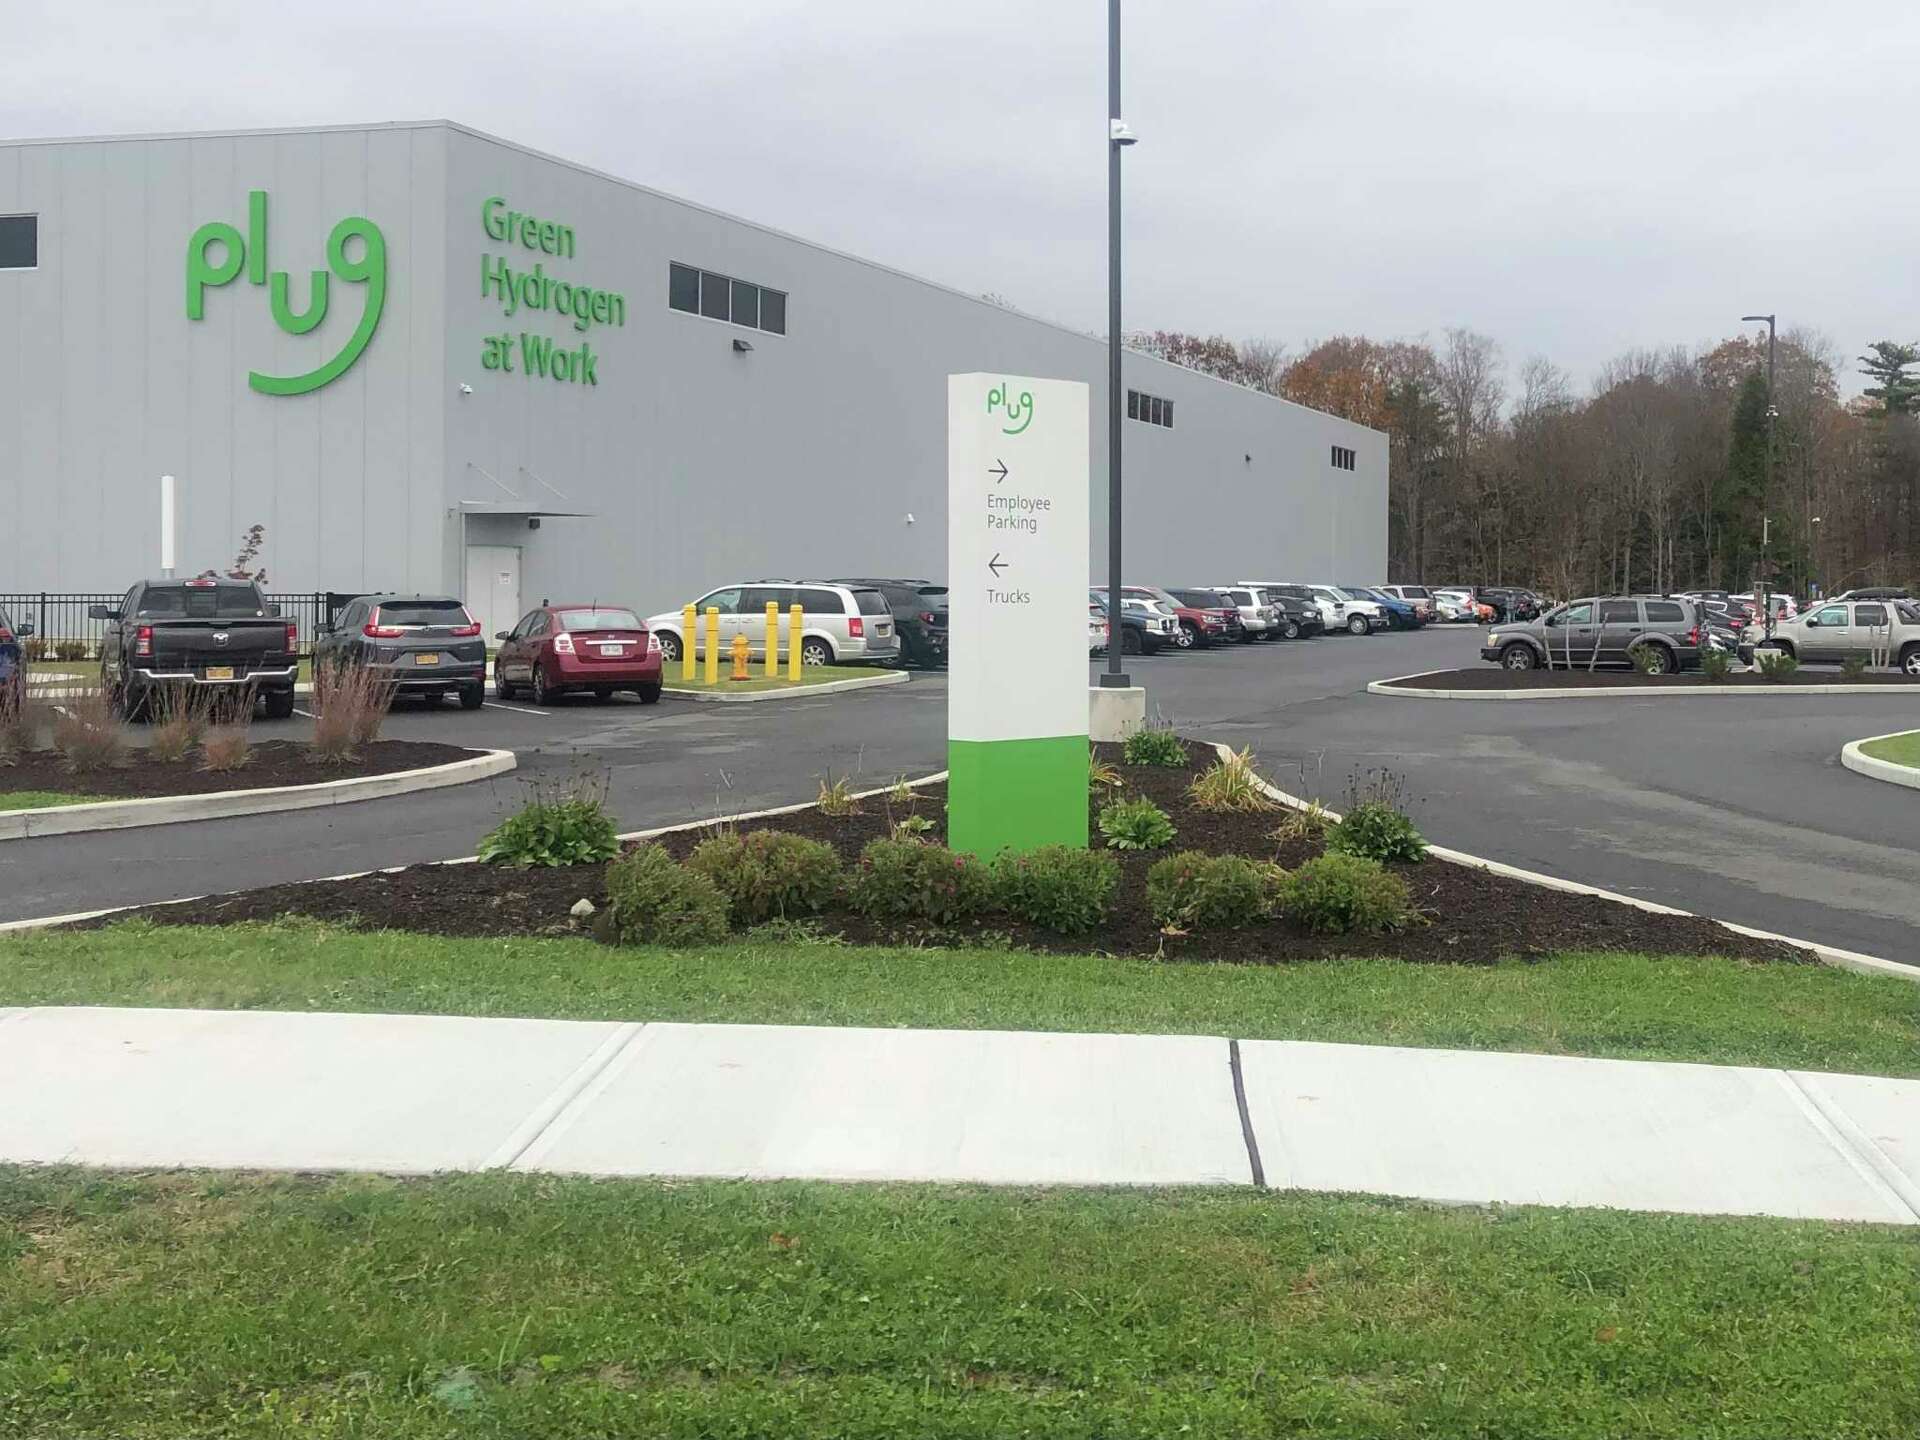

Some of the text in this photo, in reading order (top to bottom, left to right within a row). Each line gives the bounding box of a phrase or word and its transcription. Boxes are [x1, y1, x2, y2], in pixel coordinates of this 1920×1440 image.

[482, 196, 577, 258] Green
[186, 190, 388, 396] plug
[480, 253, 626, 332] Hydrogen
[482, 332, 600, 386] at Work
[987, 382, 1034, 435] plug
[987, 493, 1051, 514] Employee
[987, 513, 1038, 535] Parking
[986, 588, 1031, 604] Trucks
